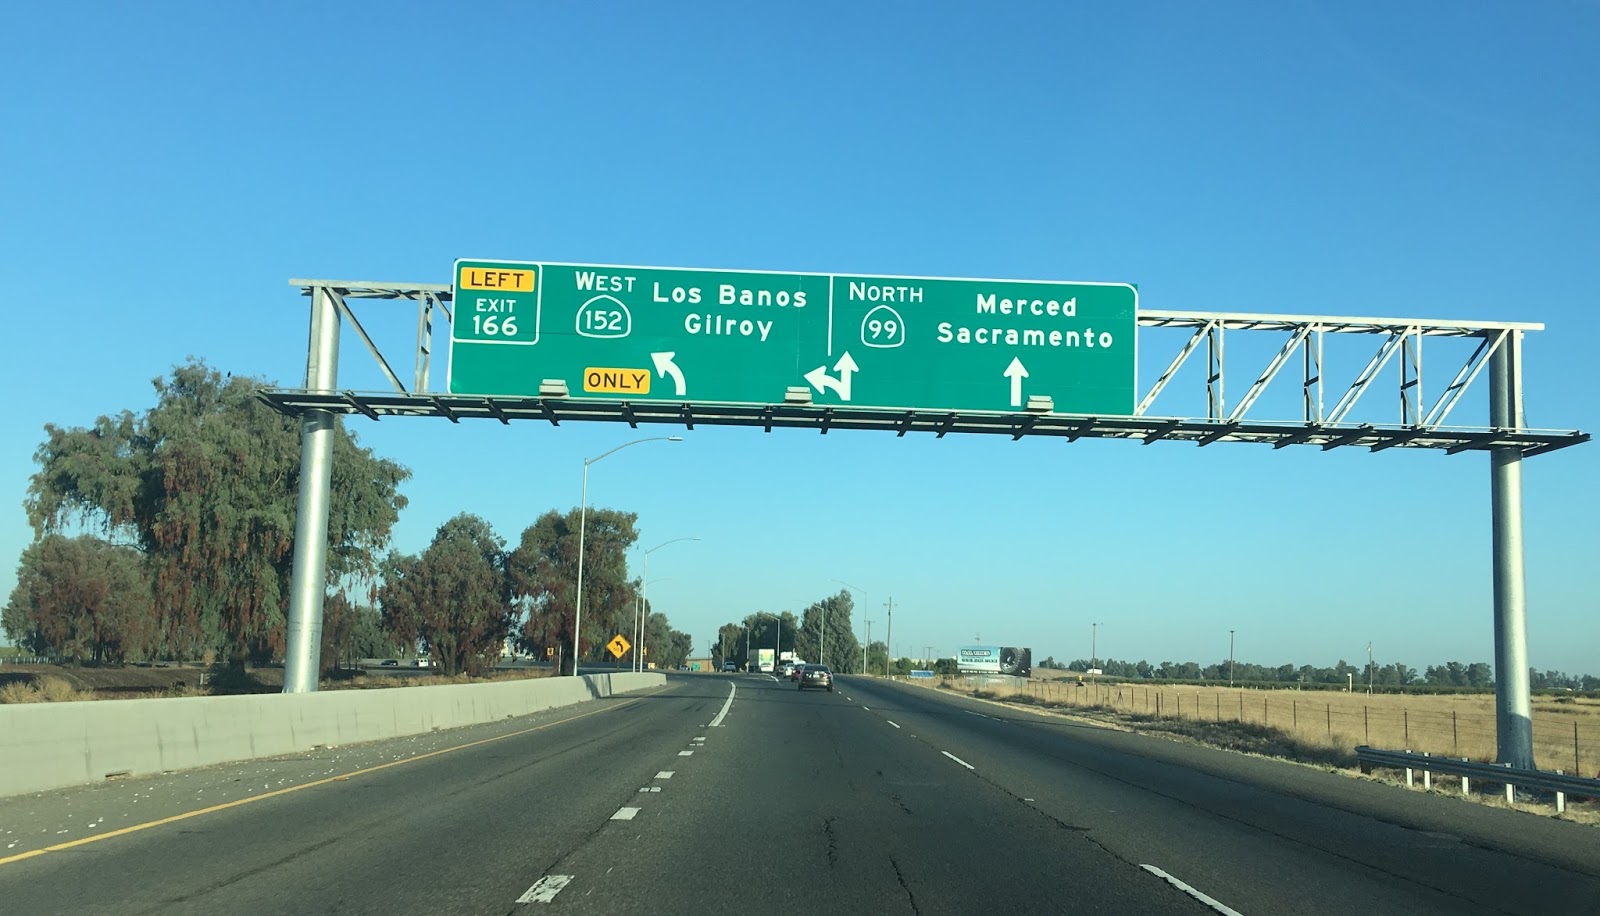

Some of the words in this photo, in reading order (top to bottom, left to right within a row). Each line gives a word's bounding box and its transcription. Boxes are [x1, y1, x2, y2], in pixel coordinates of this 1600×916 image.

[470, 271, 525, 288] LEFT
[575, 271, 637, 292] WEST
[653, 282, 702, 304] Los
[719, 284, 807, 308] Banos
[849, 281, 923, 303] NORTH
[476, 298, 517, 313] EXIT
[975, 293, 1076, 317] Merced
[473, 315, 519, 336] 166
[585, 310, 622, 330] 152
[684, 313, 774, 342] Gilroy
[868, 319, 898, 340] 99
[937, 322, 1114, 349] Sacramento
[588, 372, 647, 390] ONLY
